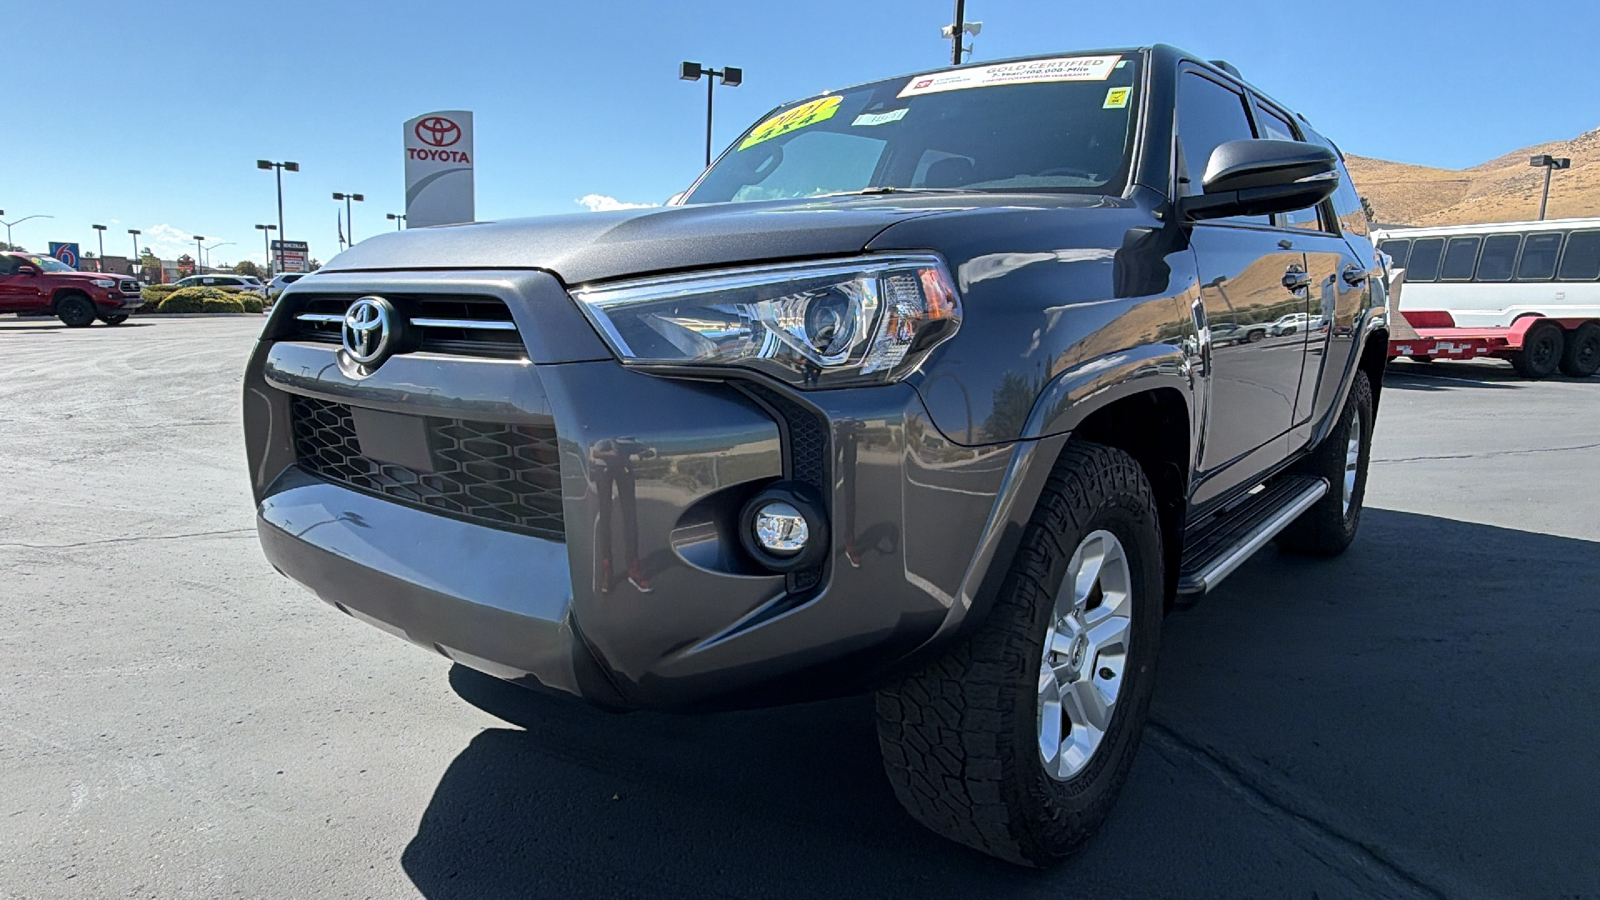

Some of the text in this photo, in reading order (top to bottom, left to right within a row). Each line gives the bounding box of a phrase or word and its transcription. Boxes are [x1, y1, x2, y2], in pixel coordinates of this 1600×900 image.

[986, 59, 1104, 73] GOLD CERTIFIED
[407, 148, 470, 163] TOYOTA
[56, 244, 76, 268] 6
